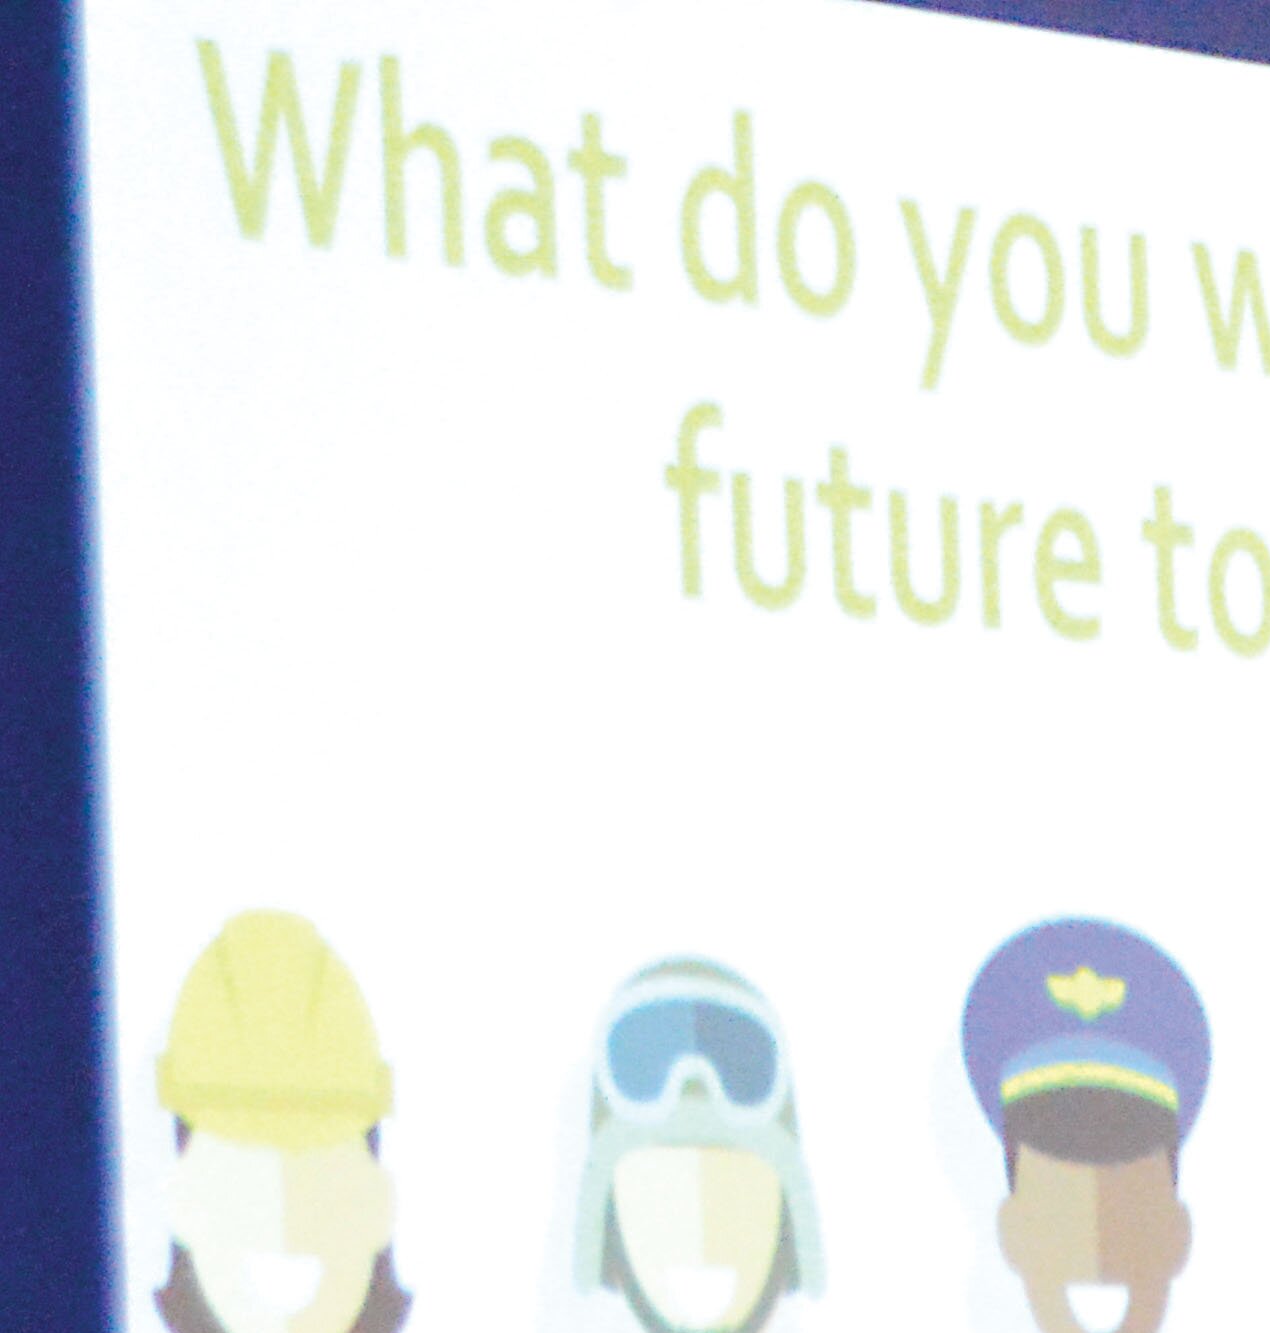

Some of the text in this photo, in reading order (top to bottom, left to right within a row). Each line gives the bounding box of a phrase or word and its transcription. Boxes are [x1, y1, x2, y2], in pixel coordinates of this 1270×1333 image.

[197, 40, 631, 290] What
[682, 111, 855, 316] do
[900, 200, 1148, 389] you
[665, 404, 1100, 640] future
